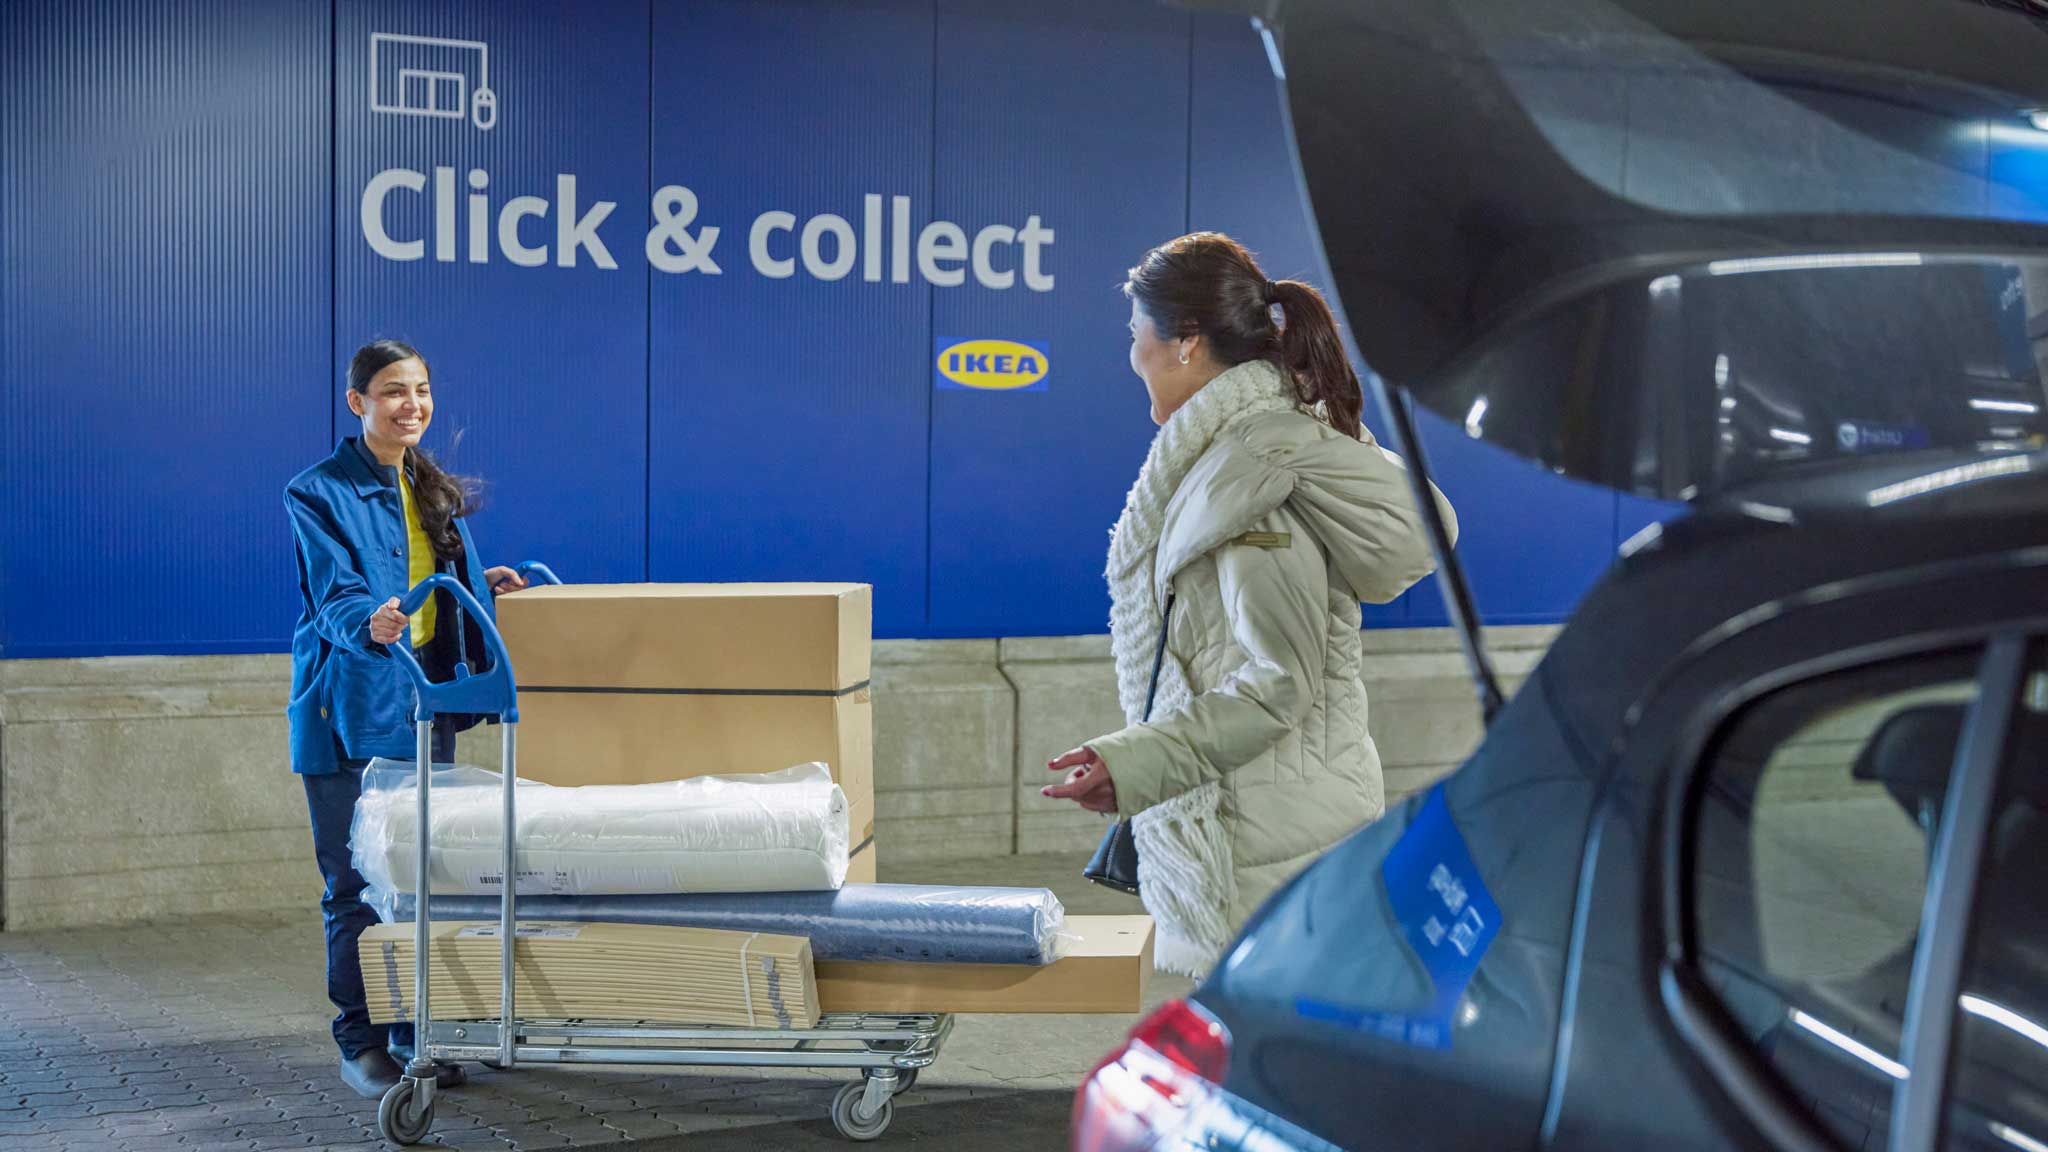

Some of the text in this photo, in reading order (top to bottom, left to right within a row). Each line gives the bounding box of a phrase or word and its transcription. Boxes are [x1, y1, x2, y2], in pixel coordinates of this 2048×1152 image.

[360, 166, 1056, 293] Click & collect
[949, 353, 1039, 374] IKEA
